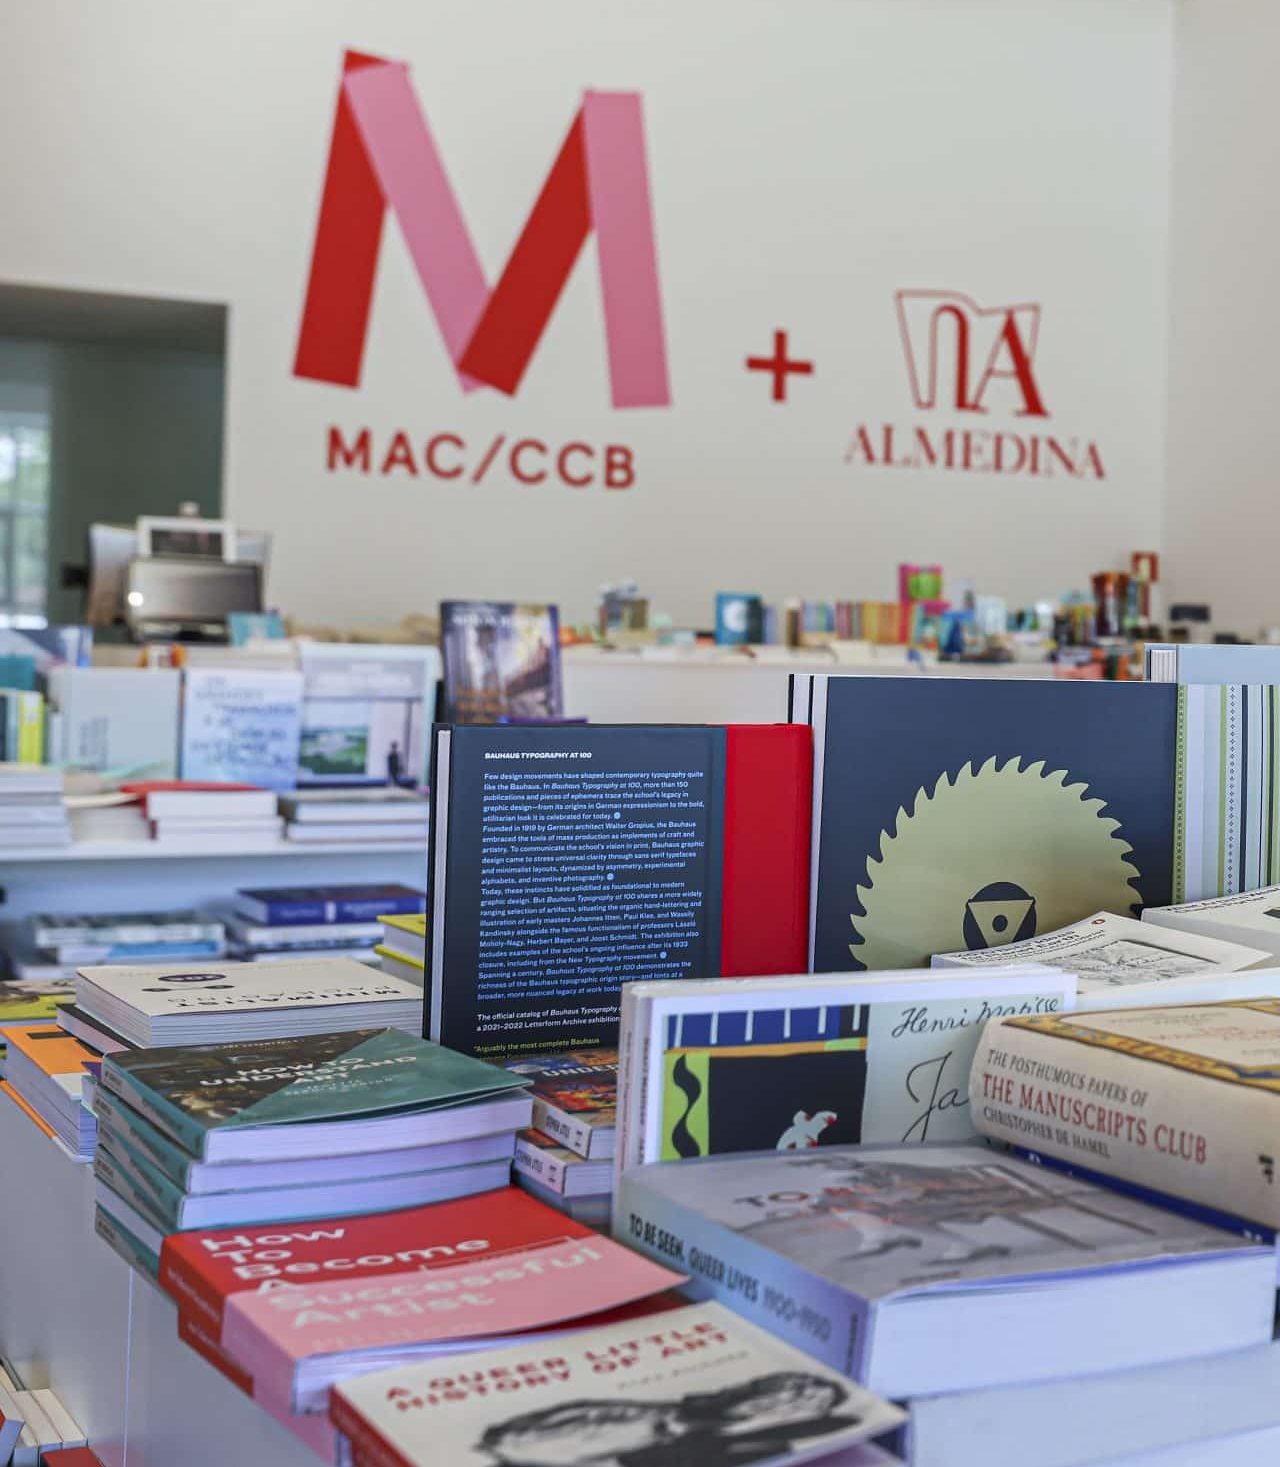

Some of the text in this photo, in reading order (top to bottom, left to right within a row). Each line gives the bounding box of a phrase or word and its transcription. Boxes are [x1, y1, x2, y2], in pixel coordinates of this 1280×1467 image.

[325, 426, 637, 490] MAC/CCB
[845, 424, 1106, 481] ALMEDINA
[892, 1007, 970, 1038] Henri
[200, 1056, 417, 1087] UNDERSTAND
[236, 1057, 364, 1077] HOW TO
[987, 1049, 1148, 1108] THE POSTHUMOUS PAPERS OF
[983, 1073, 1208, 1165] THE MANUSCRIPTS CLUB
[983, 1106, 1111, 1159] CHRISTOPHER DE HAMEL
[201, 1226, 347, 1251] How
[210, 1248, 293, 1264] To
[232, 1237, 492, 1282] Become
[630, 1213, 643, 1238] TO
[644, 1222, 657, 1247] BE
[688, 1246, 726, 1284] QUEER
[727, 1266, 760, 1302] LIVES
[268, 1245, 606, 1310] Successful
[293, 1291, 497, 1328] Artist
[396, 1368, 571, 1411] HISTORY
[661, 1331, 727, 1359] ART
[429, 1356, 566, 1389] QUEER
[584, 1322, 714, 1362] LITTLE
